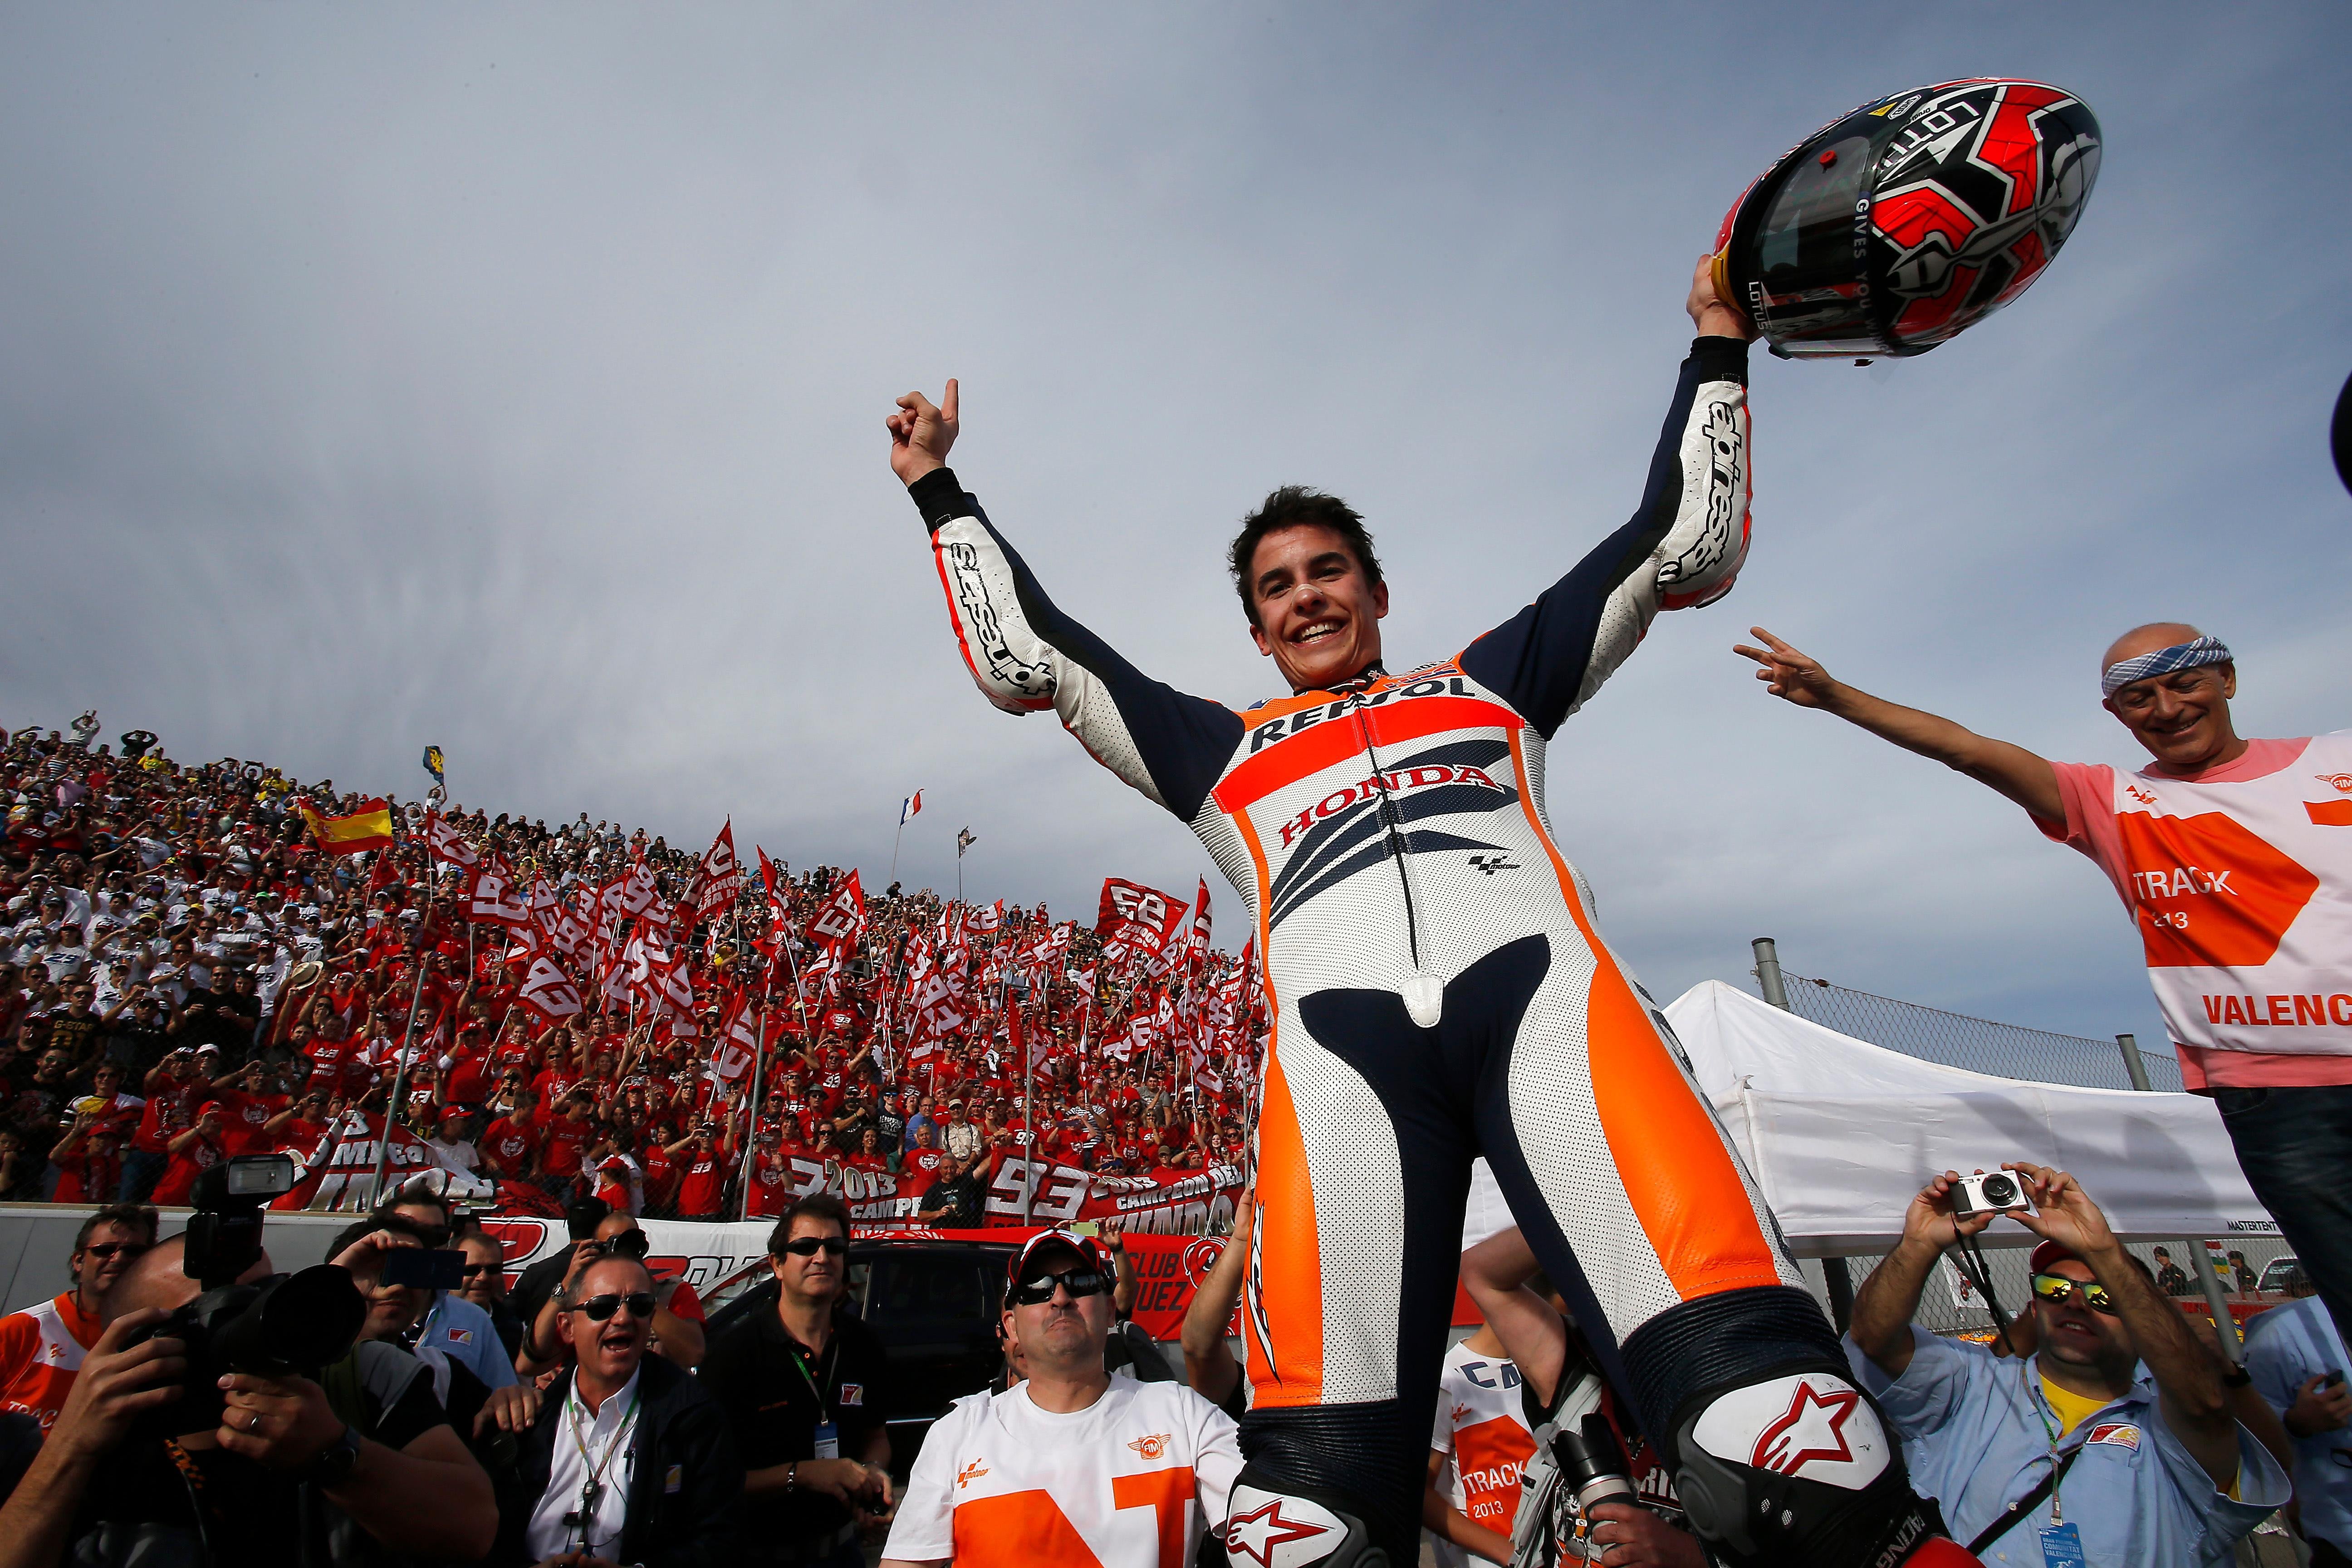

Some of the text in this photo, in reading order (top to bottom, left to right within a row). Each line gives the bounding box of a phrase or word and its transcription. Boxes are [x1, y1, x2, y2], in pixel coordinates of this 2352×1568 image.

[1853, 198, 1870, 259] GIVES
[1749, 281, 1769, 330] LOTUS
[1279, 764, 1504, 849] HONDA
[2132, 866, 2239, 900] TRACK
[2202, 994, 2352, 1026] VALENC
[823, 1075, 841, 1088] 93
[691, 1161, 713, 1174] 93
[825, 1158, 897, 1200] 2013
[1208, 1165, 1244, 1190] DEL
[985, 1157, 1092, 1220] 93
[1090, 1176, 1158, 1198] 2013
[2226, 1220, 2277, 1231] MASTERTENT
[1132, 1281, 1188, 1312] UEZ
[8, 1401, 58, 1428] TRAC
[1144, 1443, 1159, 1453] FIM
[1462, 1460, 1524, 1494] TRACK
[1473, 1499, 1504, 1519] 2013
[1875, 1507, 1926, 1568] ACING
